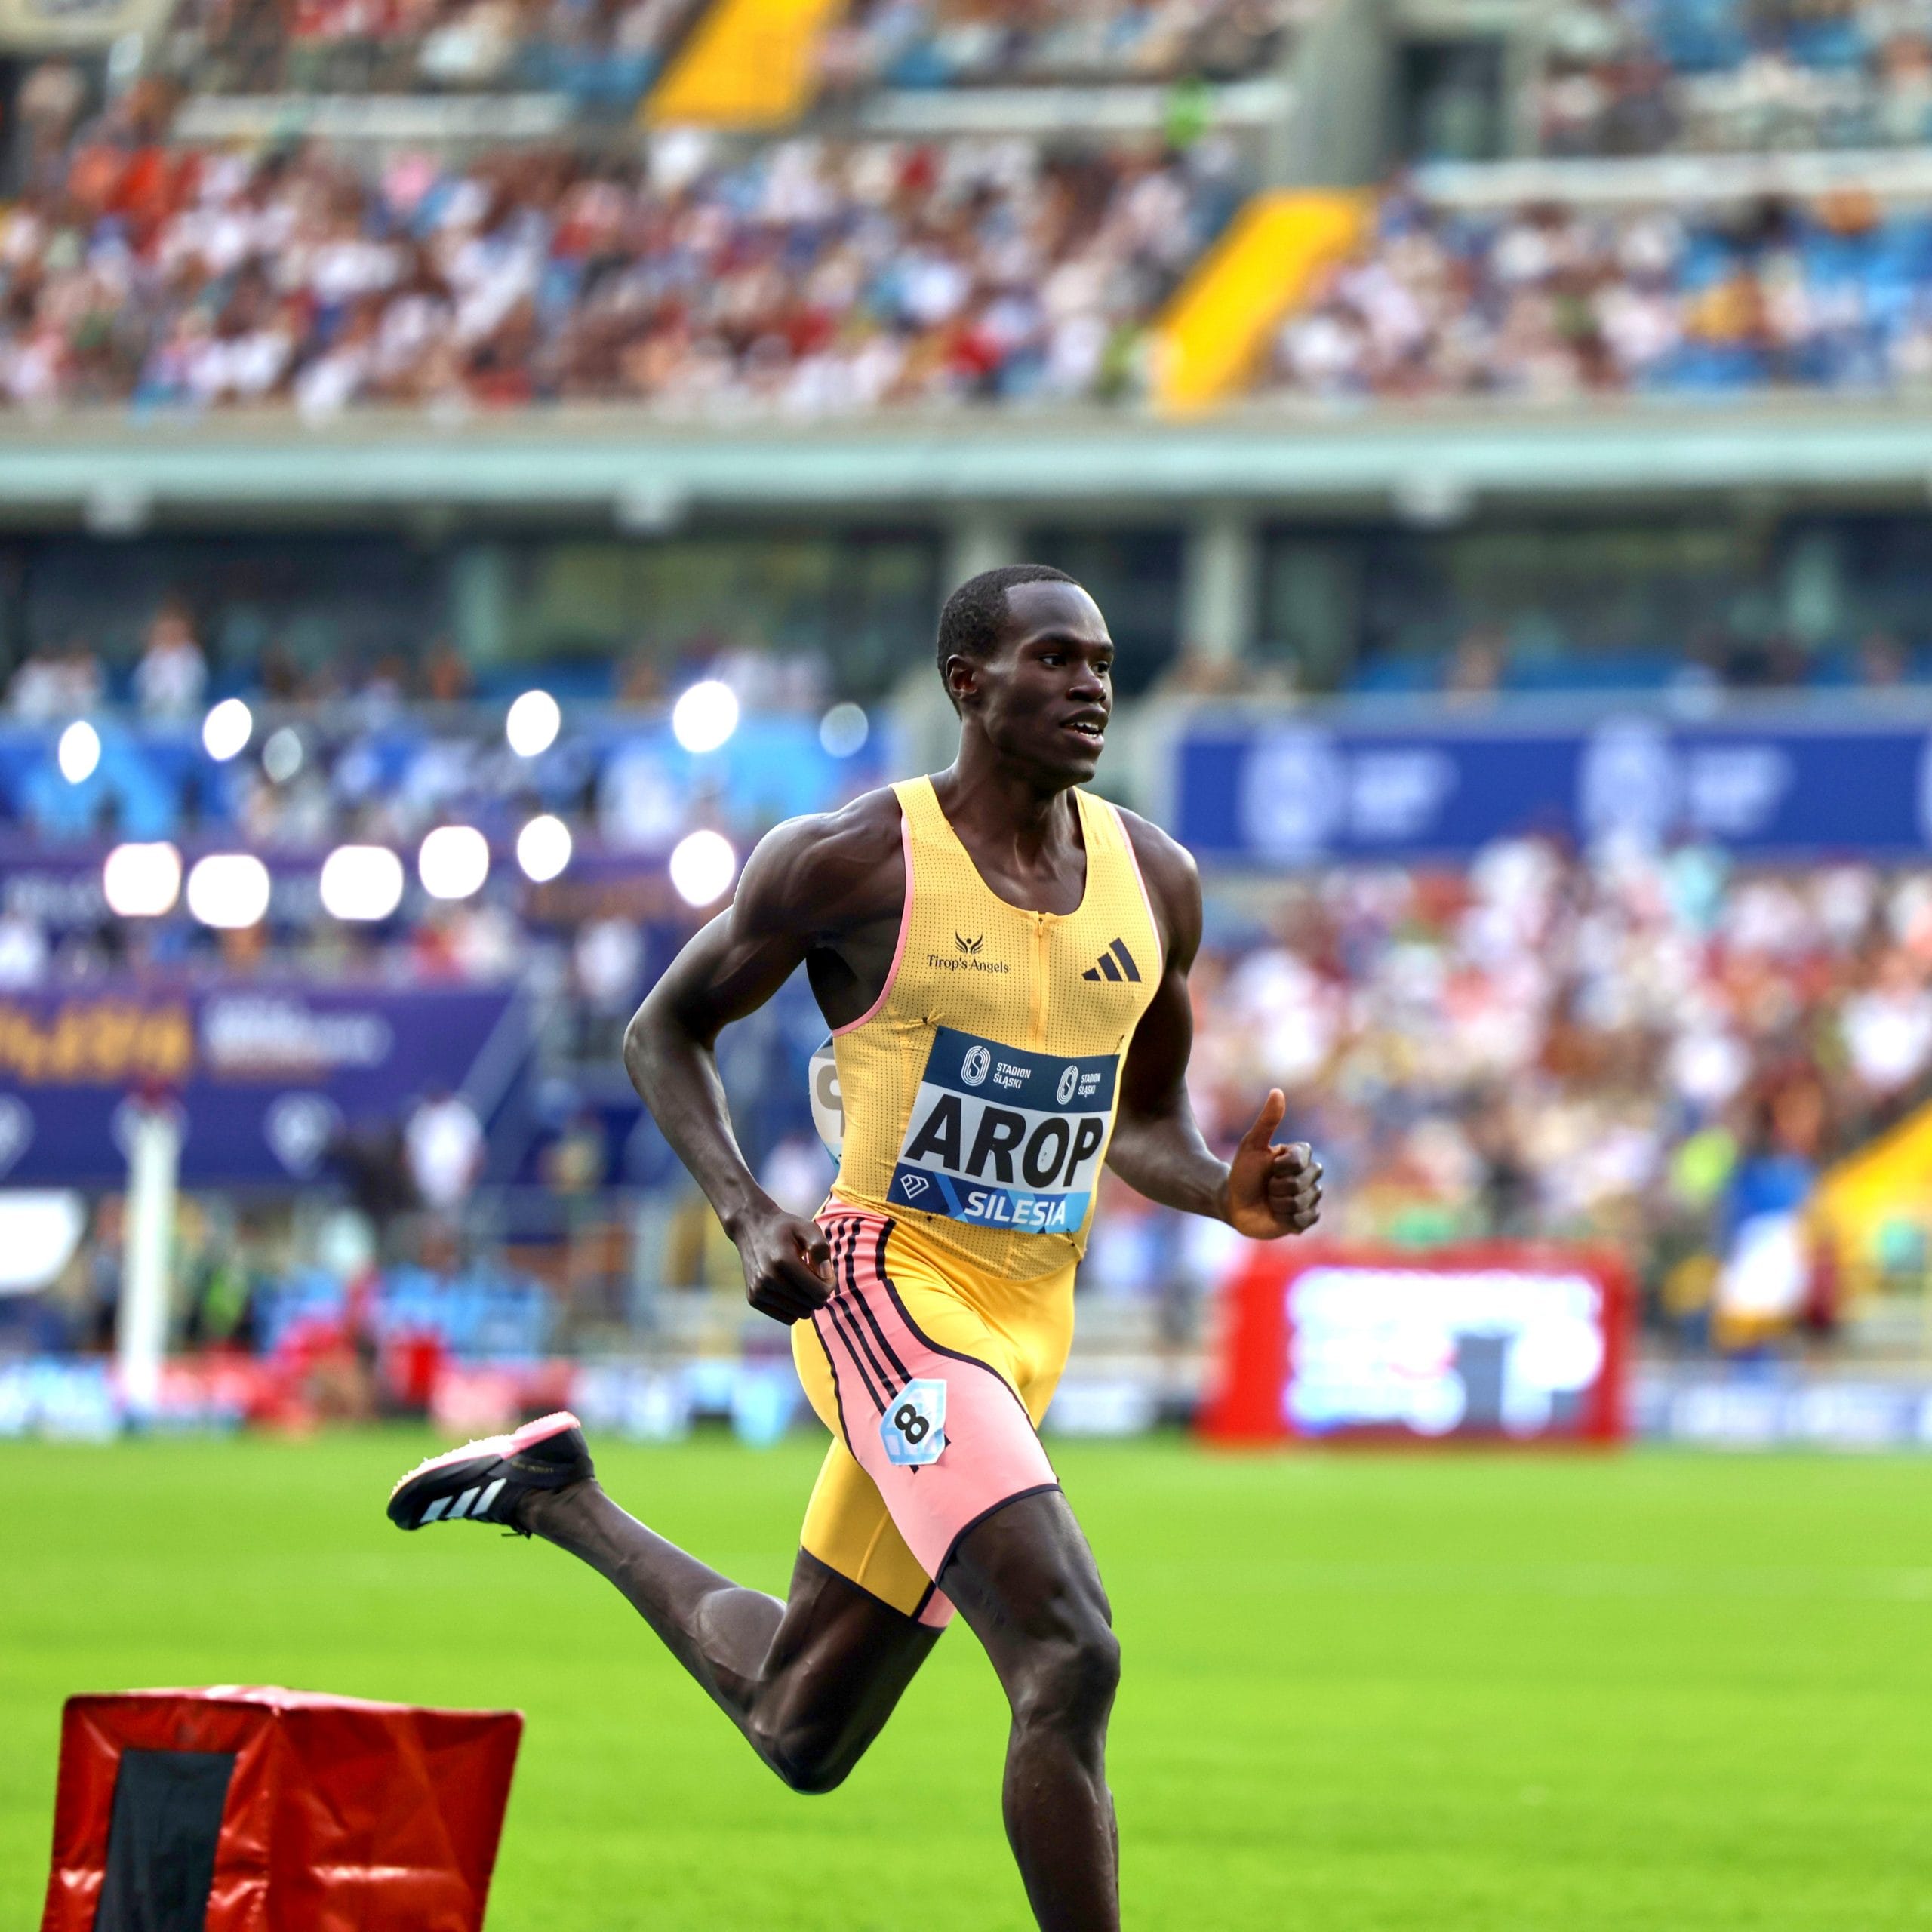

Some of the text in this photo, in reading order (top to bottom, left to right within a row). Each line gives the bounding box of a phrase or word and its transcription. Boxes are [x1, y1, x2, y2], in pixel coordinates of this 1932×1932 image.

[927, 954, 1009, 973] Tirop's Angels
[996, 1062, 1032, 1079] STADION
[1081, 1072, 1101, 1084] STADION
[992, 1072, 1022, 1089] ŚLĄSKI
[904, 1094, 1103, 1189] AROP
[964, 1191, 1066, 1226] SILESIA
[894, 1404, 929, 1444] 8
